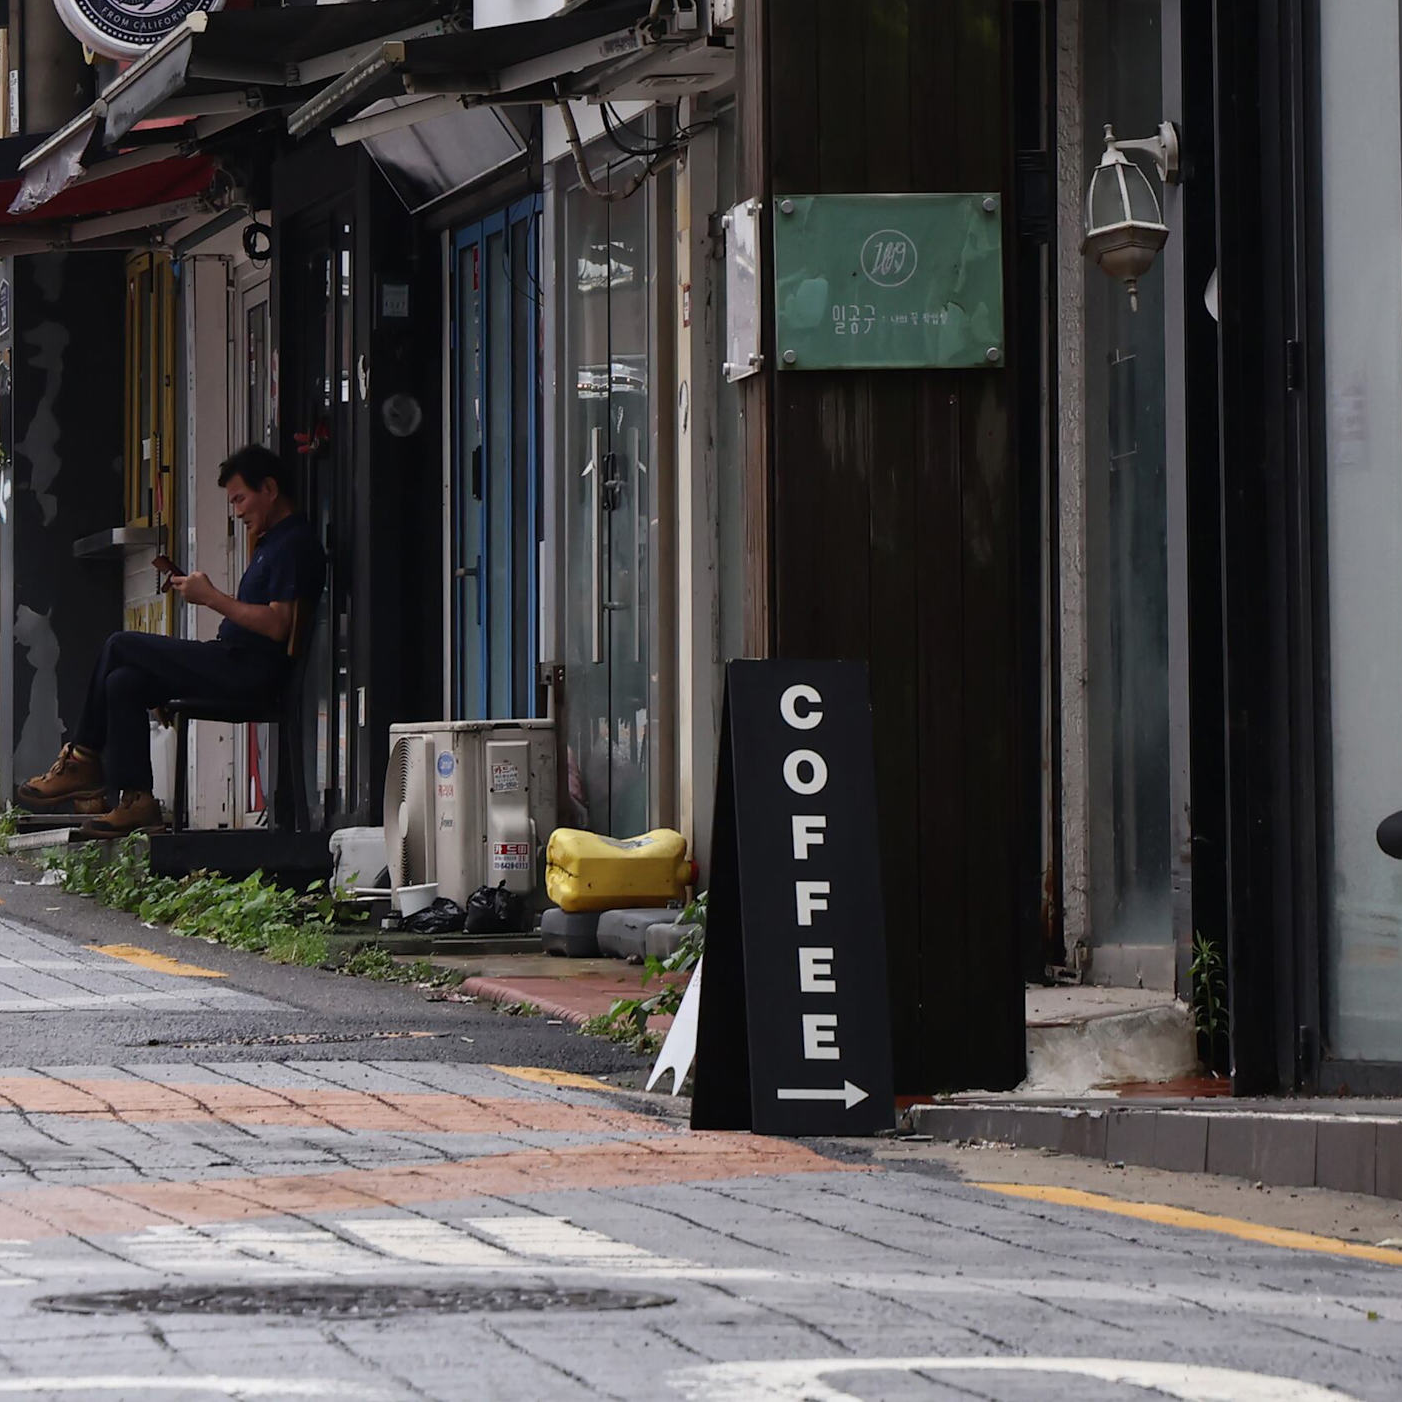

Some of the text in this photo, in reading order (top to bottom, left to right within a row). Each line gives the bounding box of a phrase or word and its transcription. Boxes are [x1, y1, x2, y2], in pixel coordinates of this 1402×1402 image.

[101, 1, 194, 30] FROM CALIFORNIA
[779, 683, 841, 1060] COFFEE
